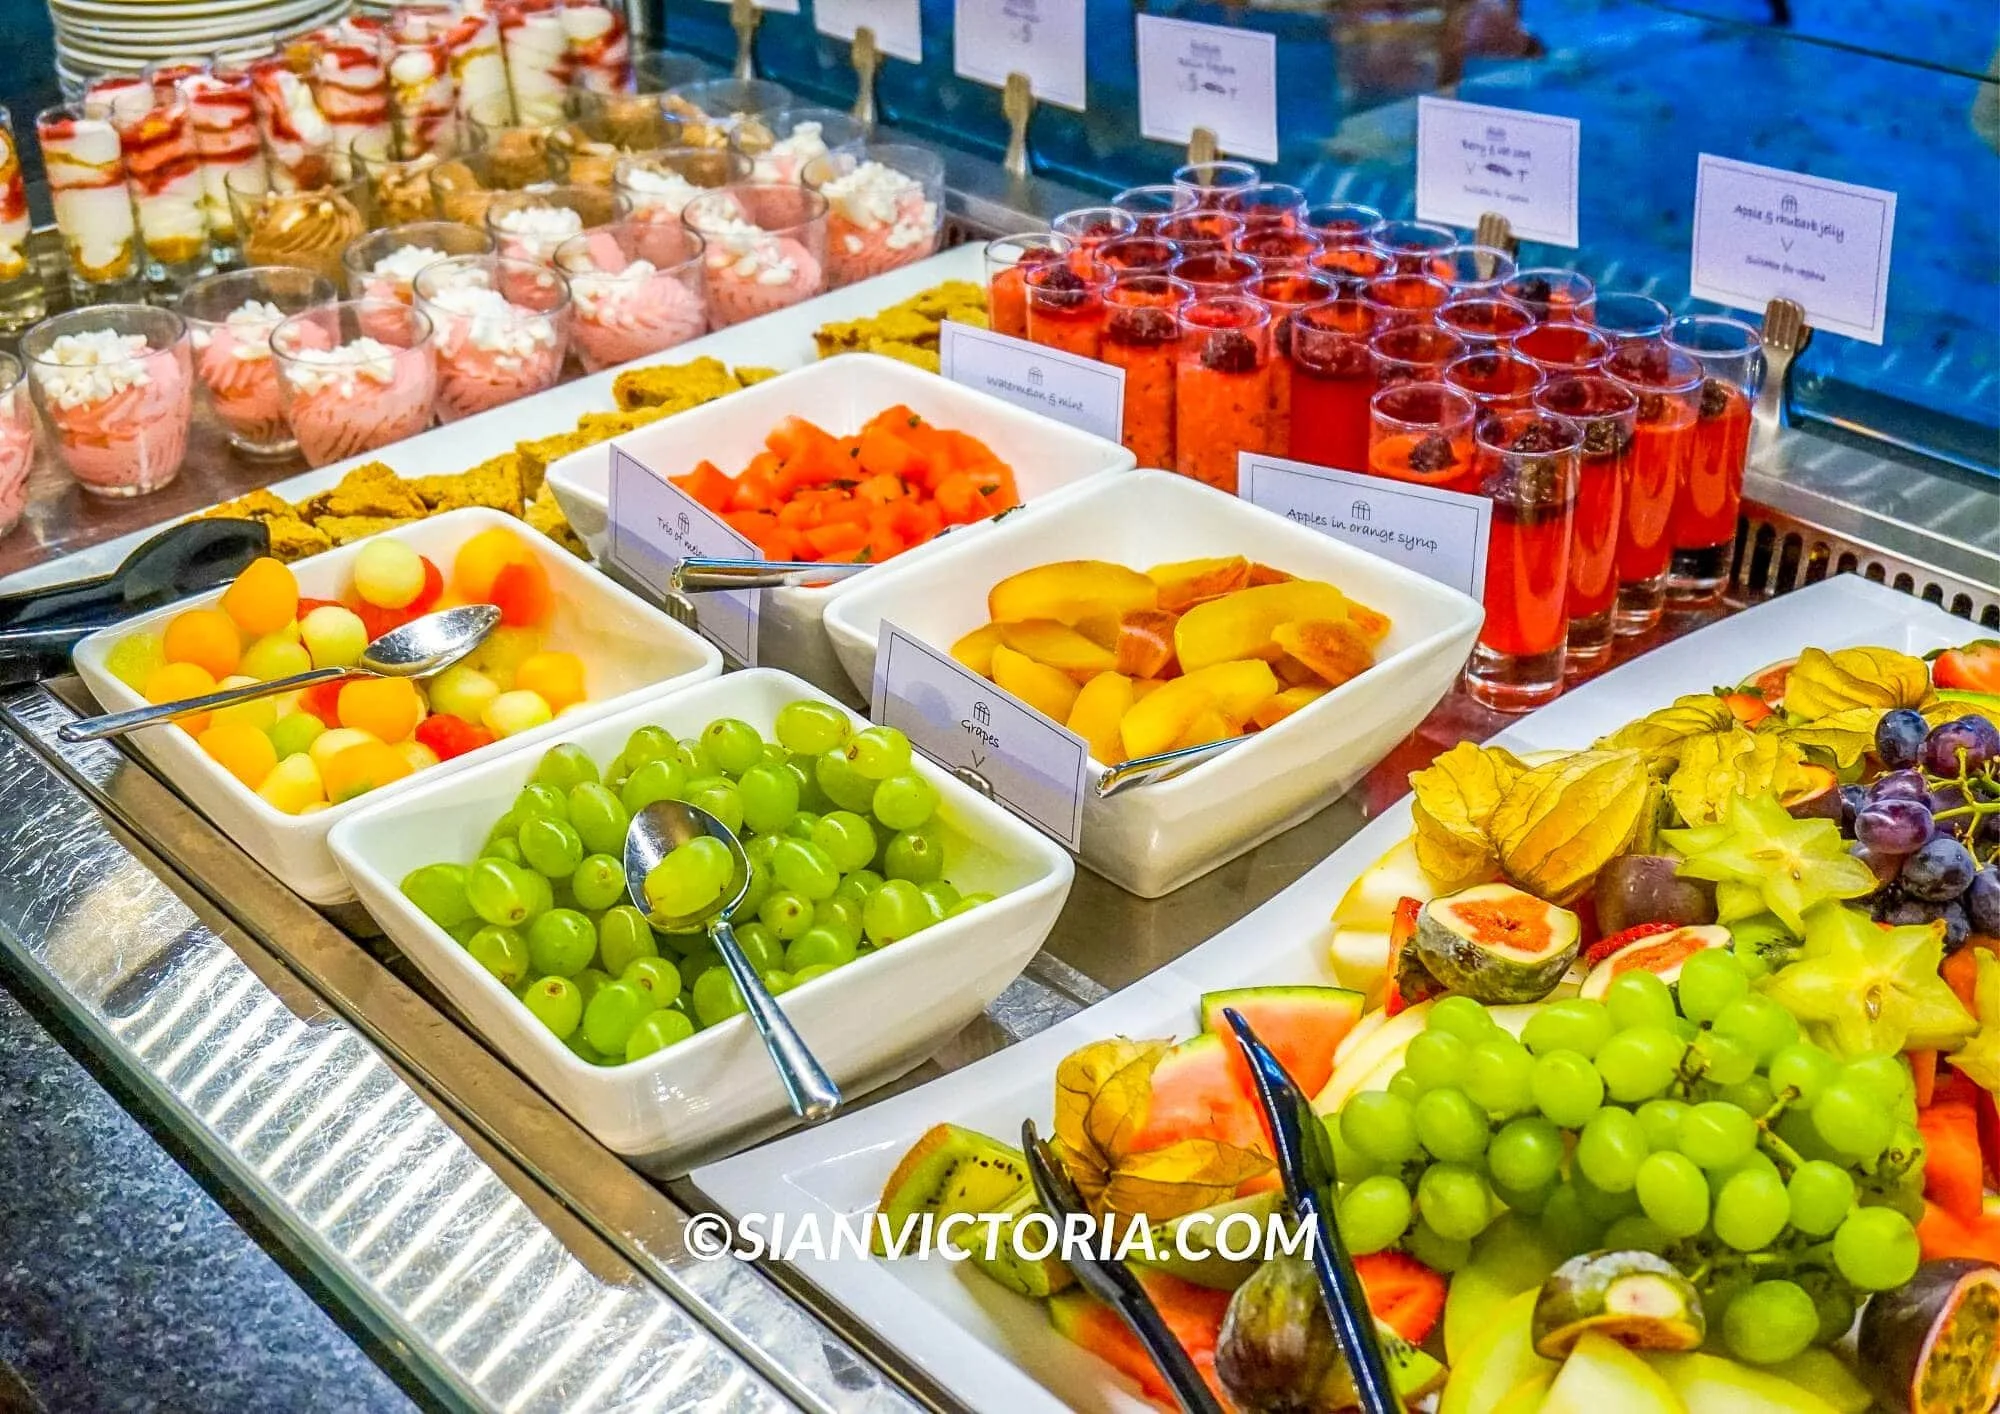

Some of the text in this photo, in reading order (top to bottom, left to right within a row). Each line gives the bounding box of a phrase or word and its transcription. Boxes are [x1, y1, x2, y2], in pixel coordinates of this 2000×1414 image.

[1734, 204, 1762, 222] Apple
[1776, 215, 1818, 232] rhubarb
[1818, 221, 1844, 244] jelly
[986, 375, 1046, 401] Watermelon
[1058, 395, 1084, 413] mint
[657, 515, 673, 536] Trio
[674, 531, 684, 547] of
[1286, 508, 1438, 554] Apples in orange syrup
[961, 719, 999, 748] Grapes
